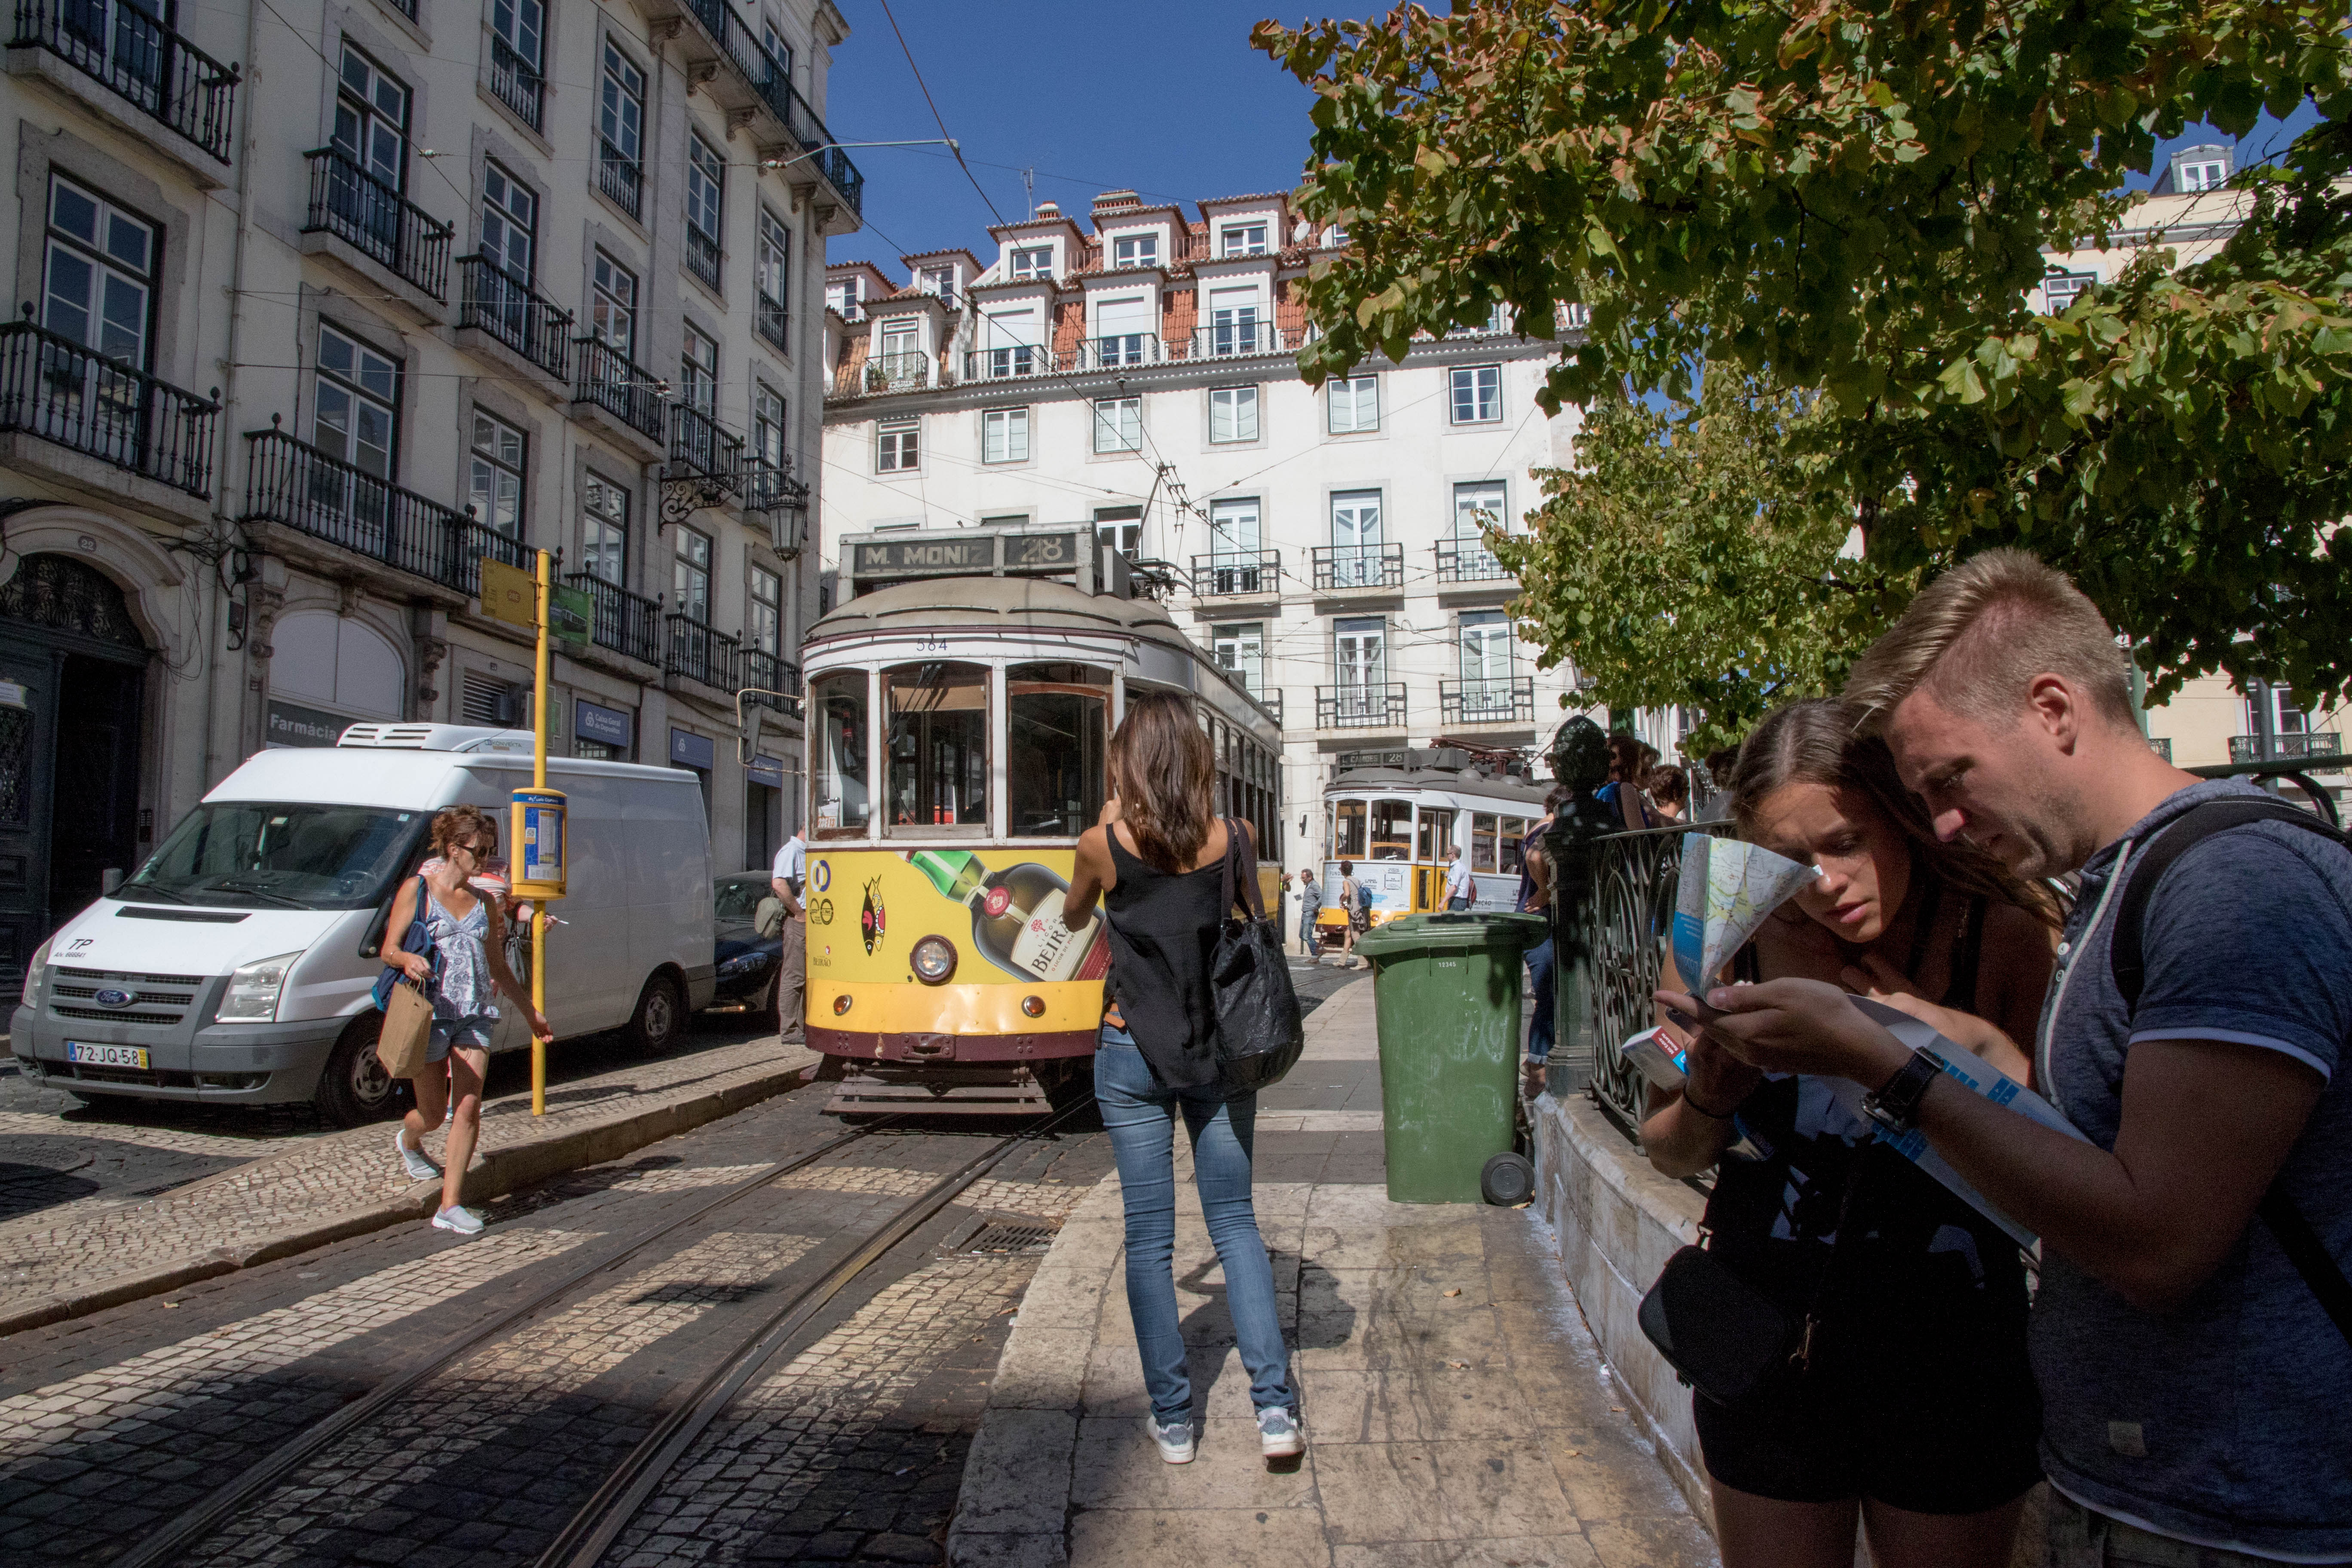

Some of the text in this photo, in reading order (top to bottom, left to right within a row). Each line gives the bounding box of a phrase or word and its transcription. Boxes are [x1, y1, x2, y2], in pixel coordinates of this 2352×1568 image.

[82, 540, 93, 550] 22
[1021, 537, 1063, 563] 28
[865, 546, 890, 565] M.
[916, 637, 948, 651] 564
[270, 714, 337, 741] Farmácia
[595, 714, 621, 727] Caixa Geral
[1388, 753, 1403, 763] 28
[1038, 918, 1057, 948] LICOR
[68, 939, 94, 949] TP
[1054, 952, 1064, 967] LICOR
[100, 990, 122, 1002] Ford
